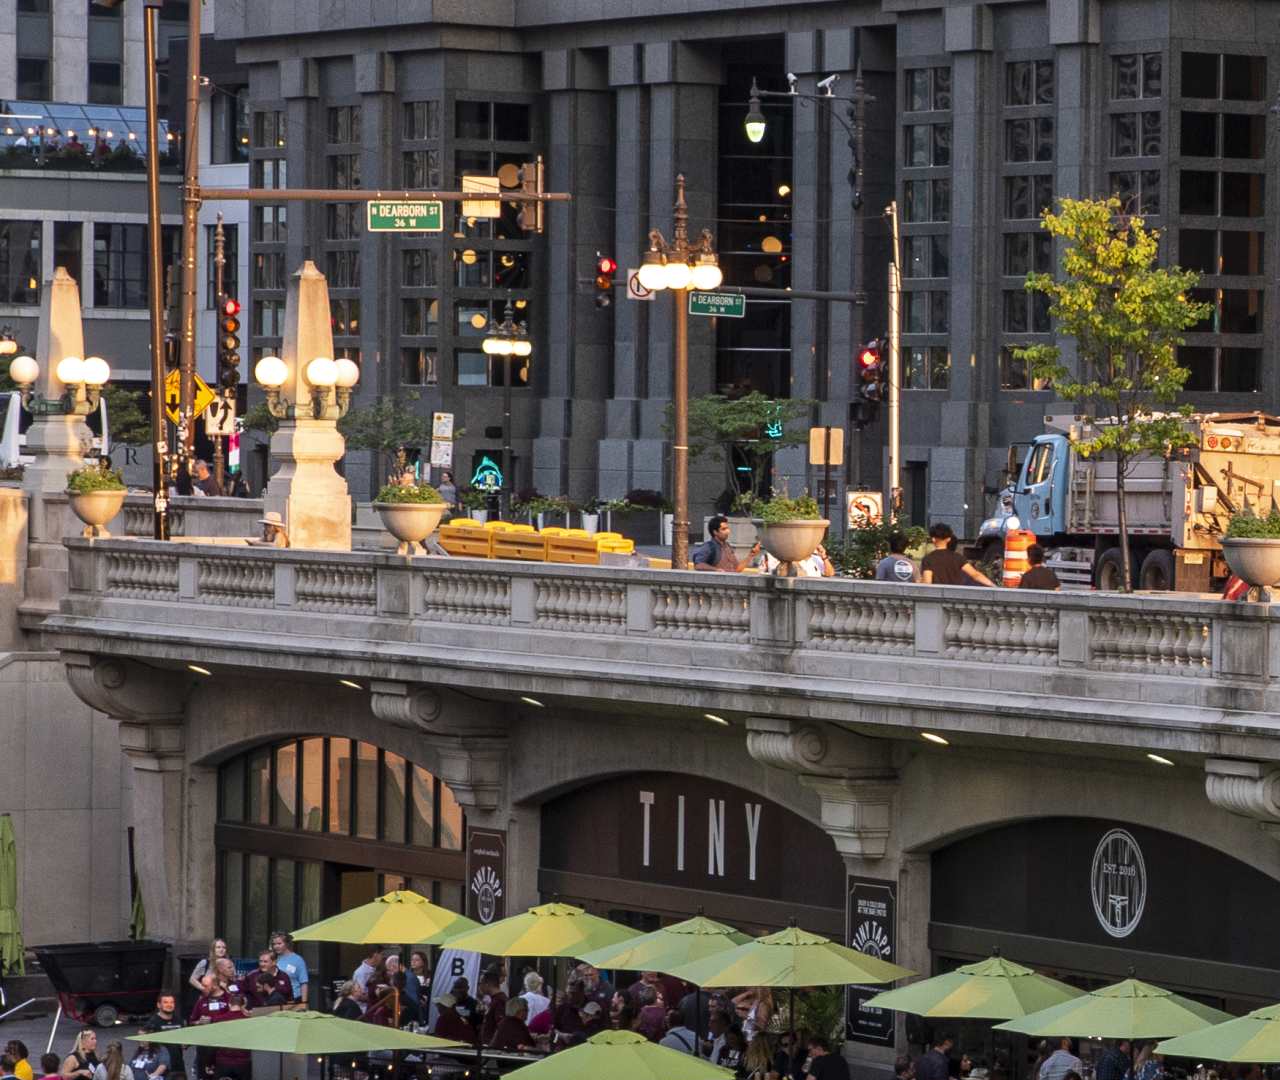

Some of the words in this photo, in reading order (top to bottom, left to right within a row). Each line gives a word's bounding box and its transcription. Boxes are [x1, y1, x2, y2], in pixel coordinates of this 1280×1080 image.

[380, 205, 427, 216] DEARBORN
[429, 206, 438, 215] ST
[394, 219, 406, 227] 36
[410, 218, 416, 227] W
[698, 295, 734, 306] DEARBORN
[640, 790, 762, 881] TINY
[472, 866, 486, 894] TINY
[487, 866, 502, 897] TAPP
[852, 920, 870, 951] TINY
[872, 920, 891, 956] TAPP
[451, 958, 464, 976] B
